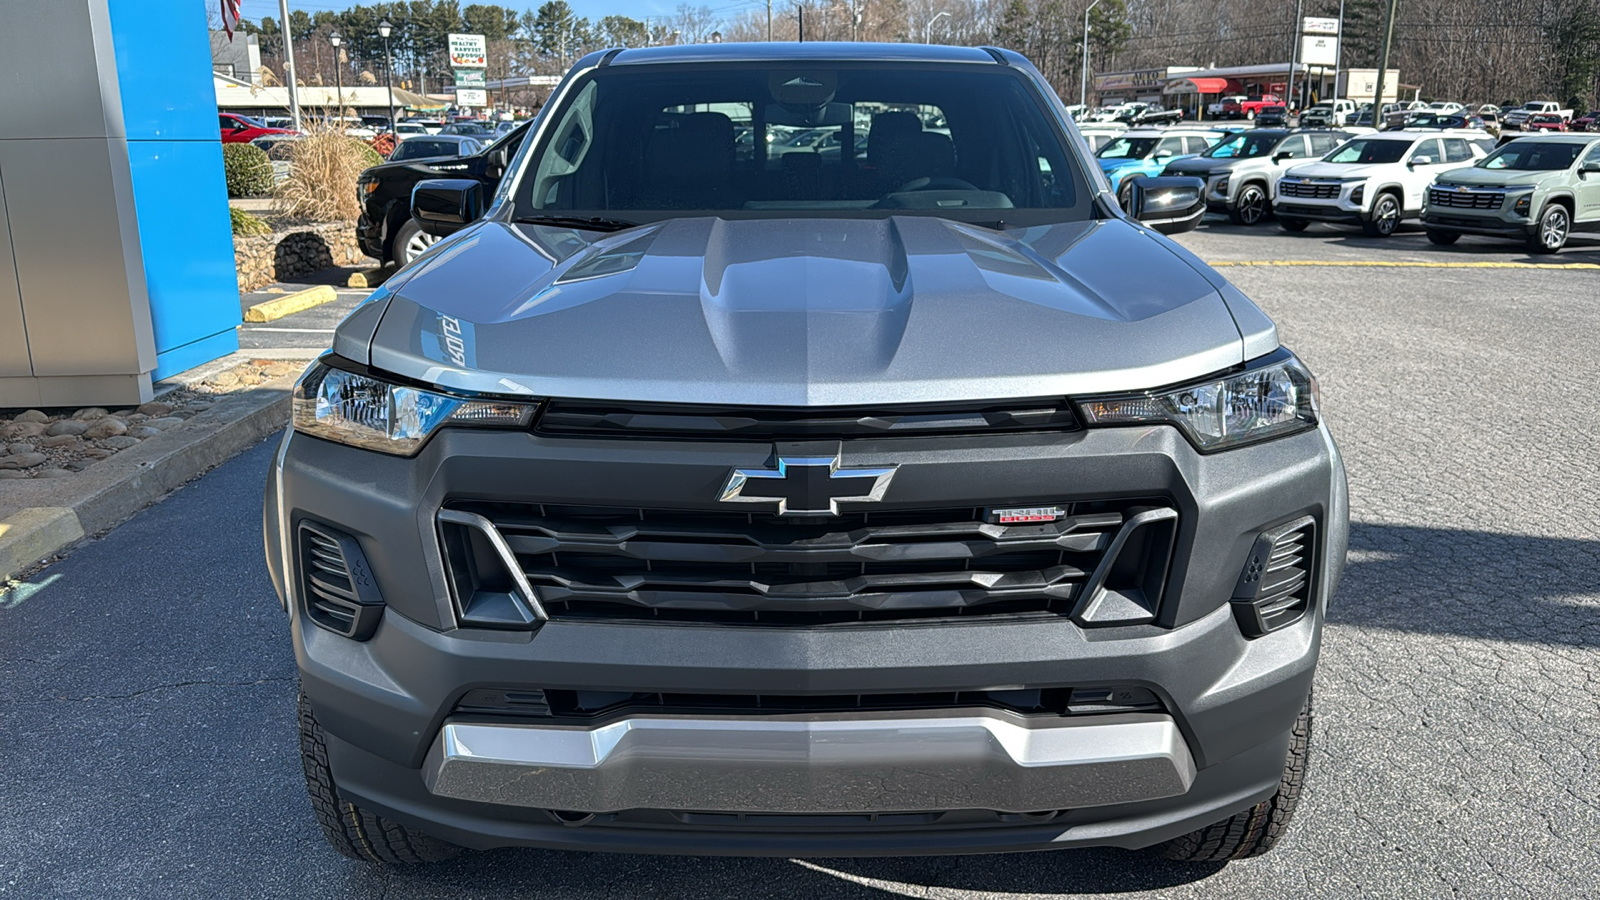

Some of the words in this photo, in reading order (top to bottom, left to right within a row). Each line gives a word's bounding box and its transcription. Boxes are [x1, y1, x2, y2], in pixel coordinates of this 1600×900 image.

[1133, 71, 1159, 80] AUTO
[1131, 79, 1158, 87] MART
[992, 507, 1065, 516] TRAIL
